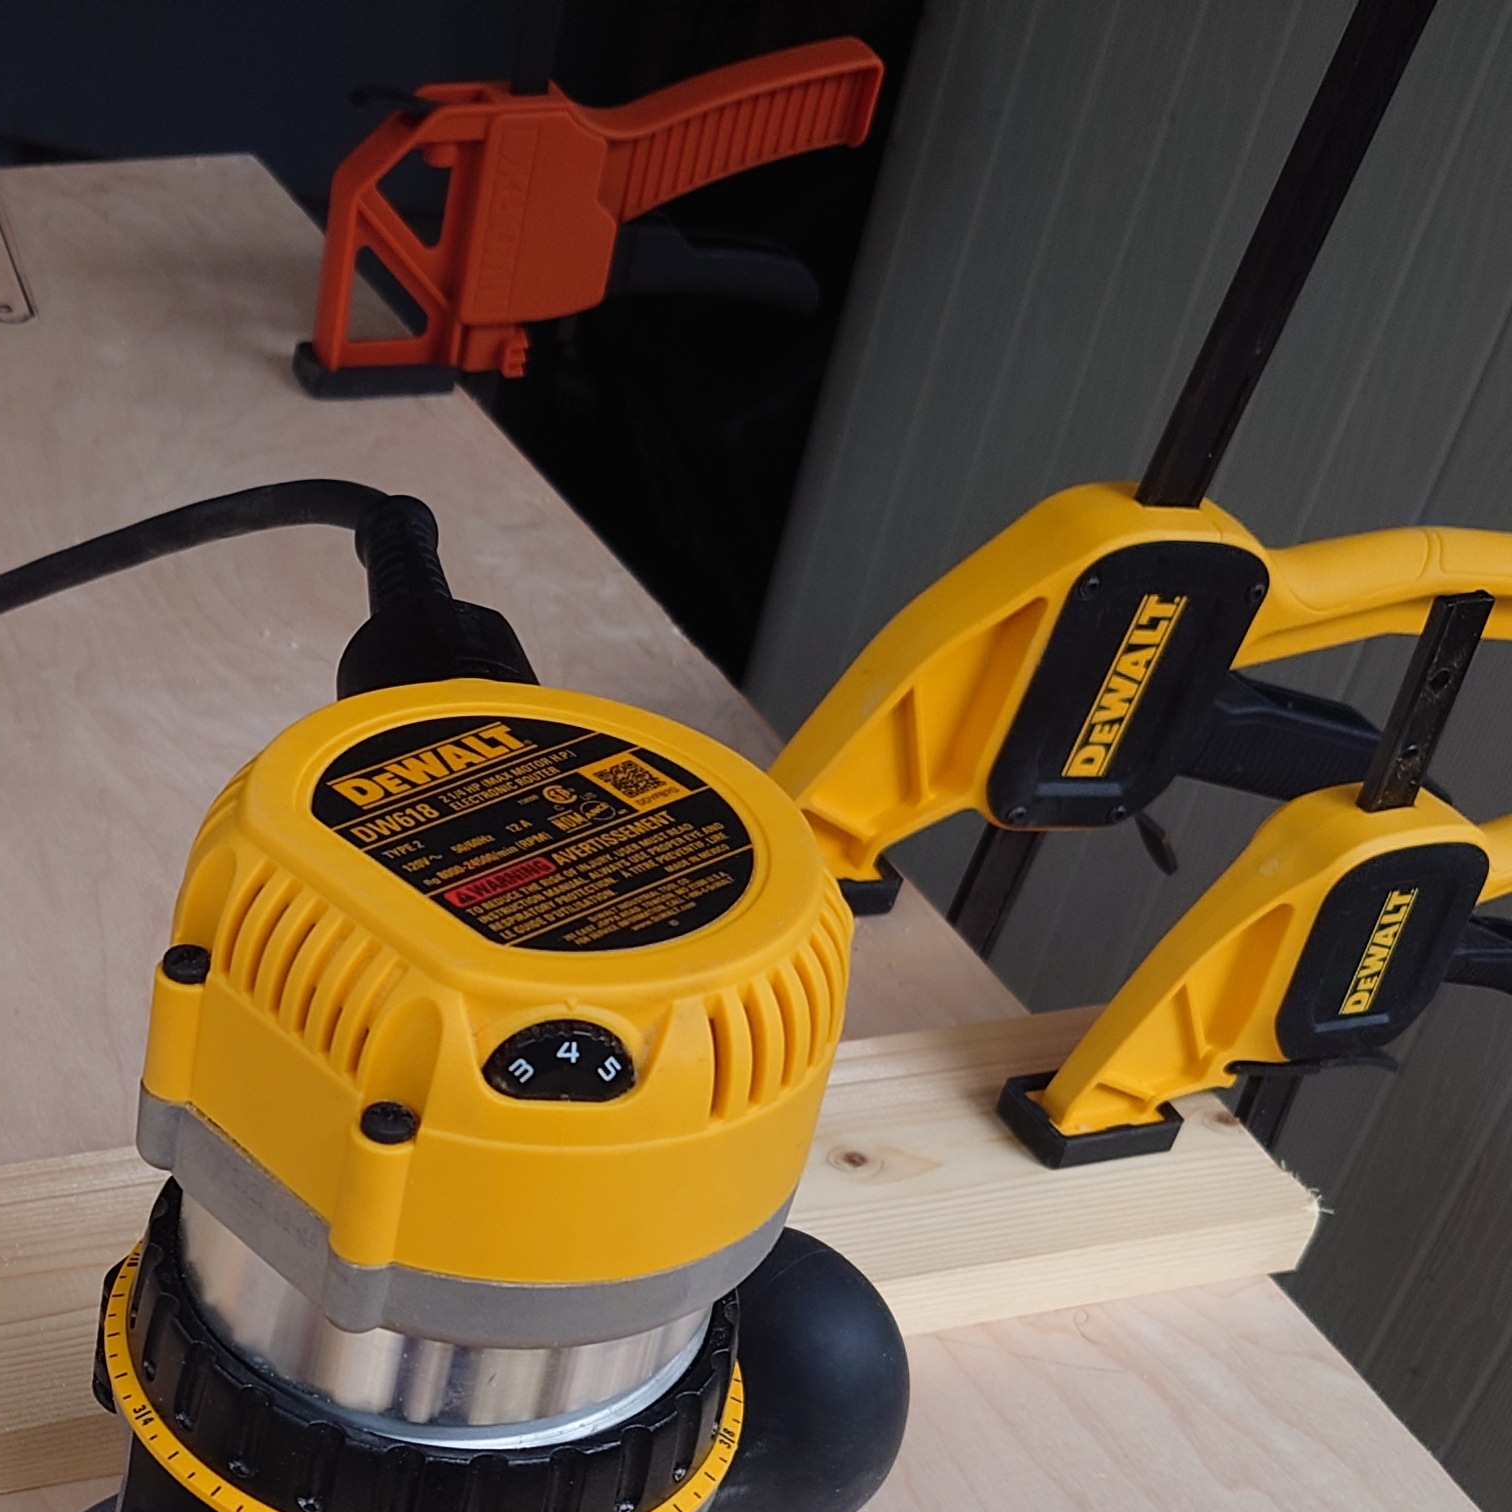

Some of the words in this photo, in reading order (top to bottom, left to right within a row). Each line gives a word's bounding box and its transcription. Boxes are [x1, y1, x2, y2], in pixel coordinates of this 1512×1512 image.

[448, 781, 518, 810] ELECTRONIC
[515, 766, 560, 785] ROUTER
[463, 783, 483, 793] HP
[480, 772, 514, 787] (MAX
[510, 757, 552, 776] MOTOR
[349, 801, 441, 843] DW618
[549, 810, 677, 864] AVERTISSEMENT
[551, 811, 587, 831] NOM
[381, 843, 416, 859] TYPE
[514, 831, 553, 849] (RPM)
[401, 857, 432, 872] 120V
[466, 906, 484, 915] TO
[480, 891, 522, 909] REDUCE
[519, 883, 542, 893] THE
[539, 873, 565, 886] RISK
[562, 868, 579, 877] OF
[637, 832, 669, 847] MUST
[665, 822, 694, 836] READ
[466, 860, 550, 896] WARNING
[475, 893, 546, 923] INSTRUCTION
[586, 859, 631, 879] ALWAYS
[627, 851, 651, 862] USE
[646, 837, 686, 855] PROPER
[682, 830, 704, 841] EYE
[700, 822, 724, 833] AND
[663, 859, 691, 871] MADE
[487, 900, 558, 930] RESPIRATORY
[627, 859, 659, 874] TITRE
[499, 929, 516, 938] LE
[511, 917, 548, 933] GUIDE
[508, 1058, 534, 1084] 3
[556, 1041, 580, 1063] 4
[597, 1056, 622, 1082] 5
[133, 1404, 155, 1427] 3/4
